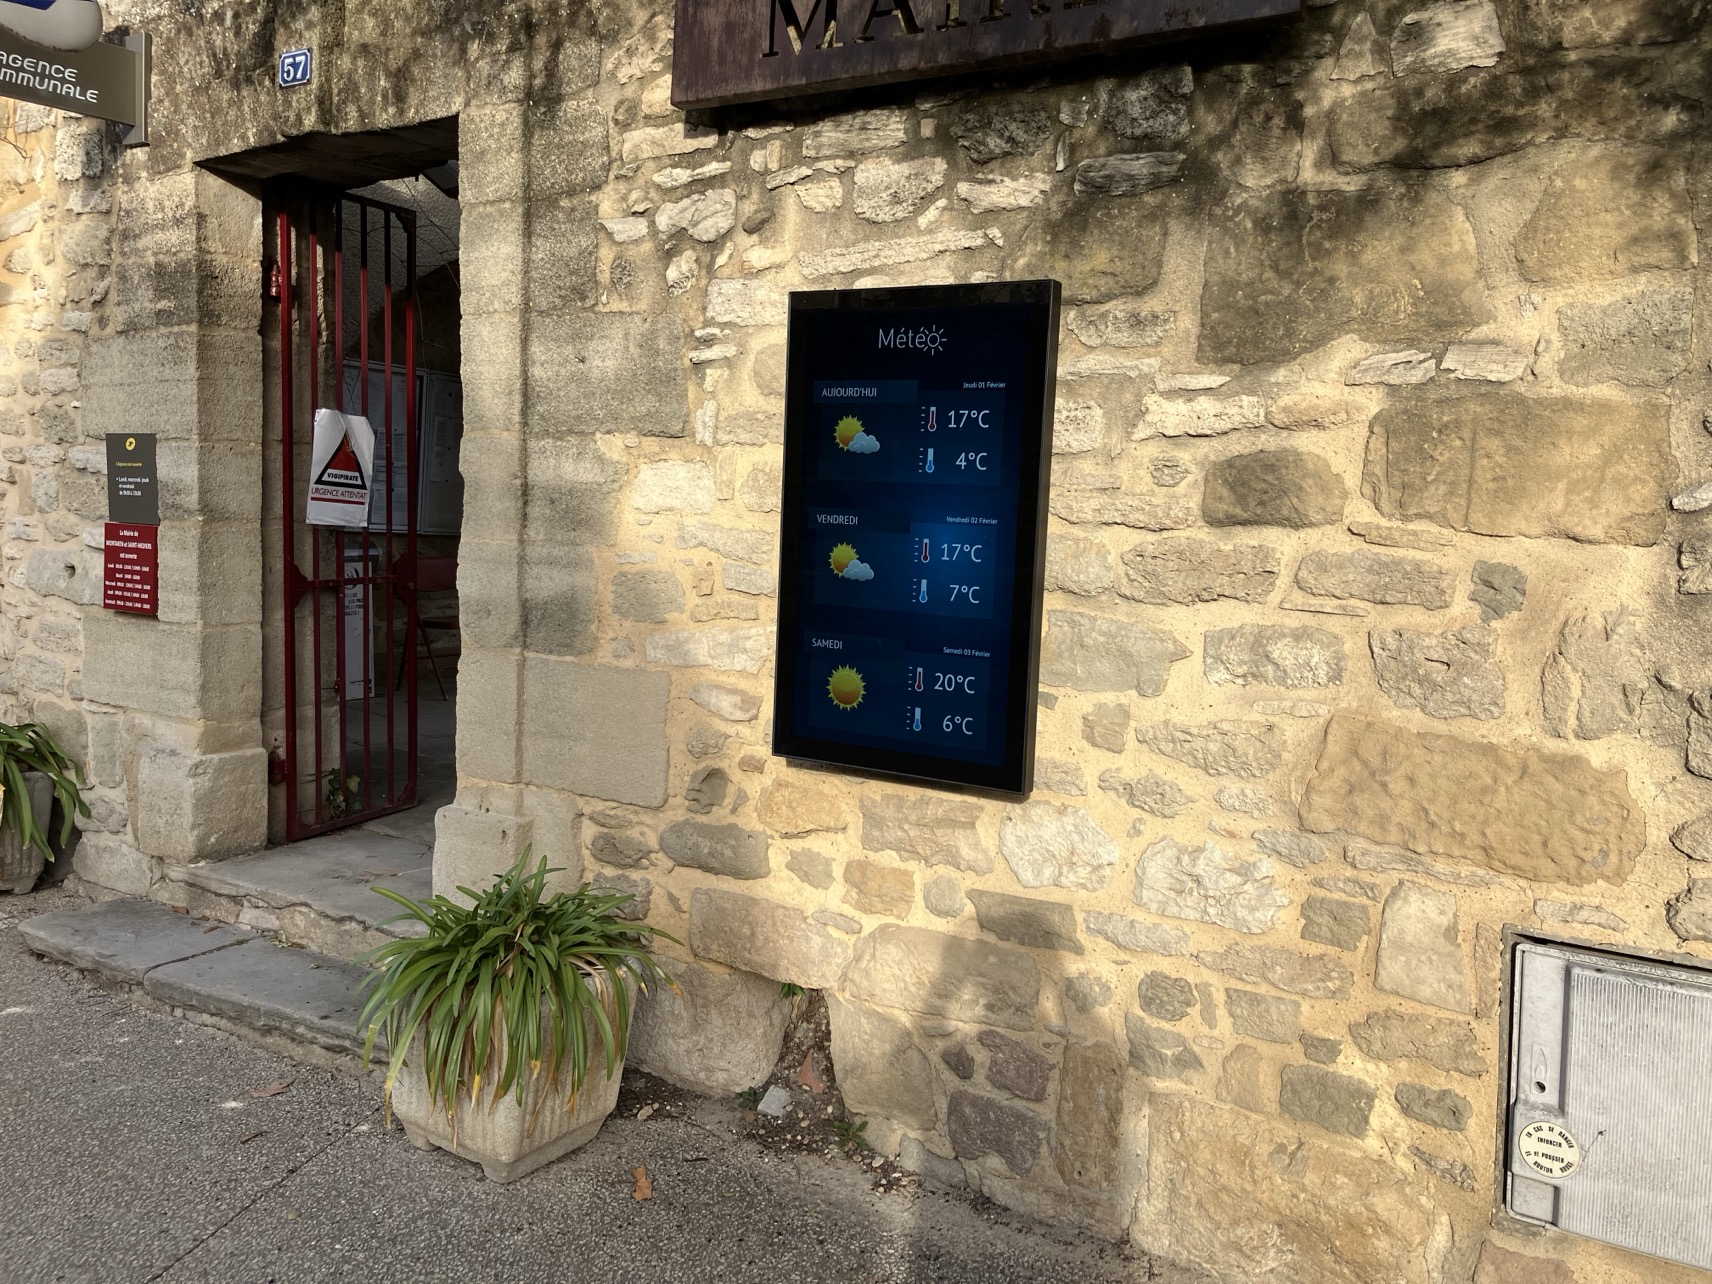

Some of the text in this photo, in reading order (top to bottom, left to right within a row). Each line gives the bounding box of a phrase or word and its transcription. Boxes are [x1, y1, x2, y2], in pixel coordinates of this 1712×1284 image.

[283, 55, 306, 82] 57
[0, 67, 99, 103] MMUNALE
[878, 326, 943, 351] Météo
[822, 387, 877, 398] AUJOURD'HUI
[962, 381, 978, 389] Jeudi
[948, 409, 990, 429] 17°C
[955, 452, 988, 471] 4°C
[327, 472, 358, 482] VIGIPIRATE
[311, 487, 367, 499] URGENCE ATTENTAT
[816, 514, 858, 526] VENDREDI
[979, 517, 998, 525] Février
[941, 543, 982, 563] 17°C
[950, 584, 980, 604] 7°C
[812, 638, 843, 650] SAMEDI
[943, 647, 962, 655] Samedi
[972, 649, 990, 658] Février
[934, 672, 975, 694] 20°C
[942, 715, 973, 735] 6°C
[1542, 1152, 1564, 1163] POUSSER
